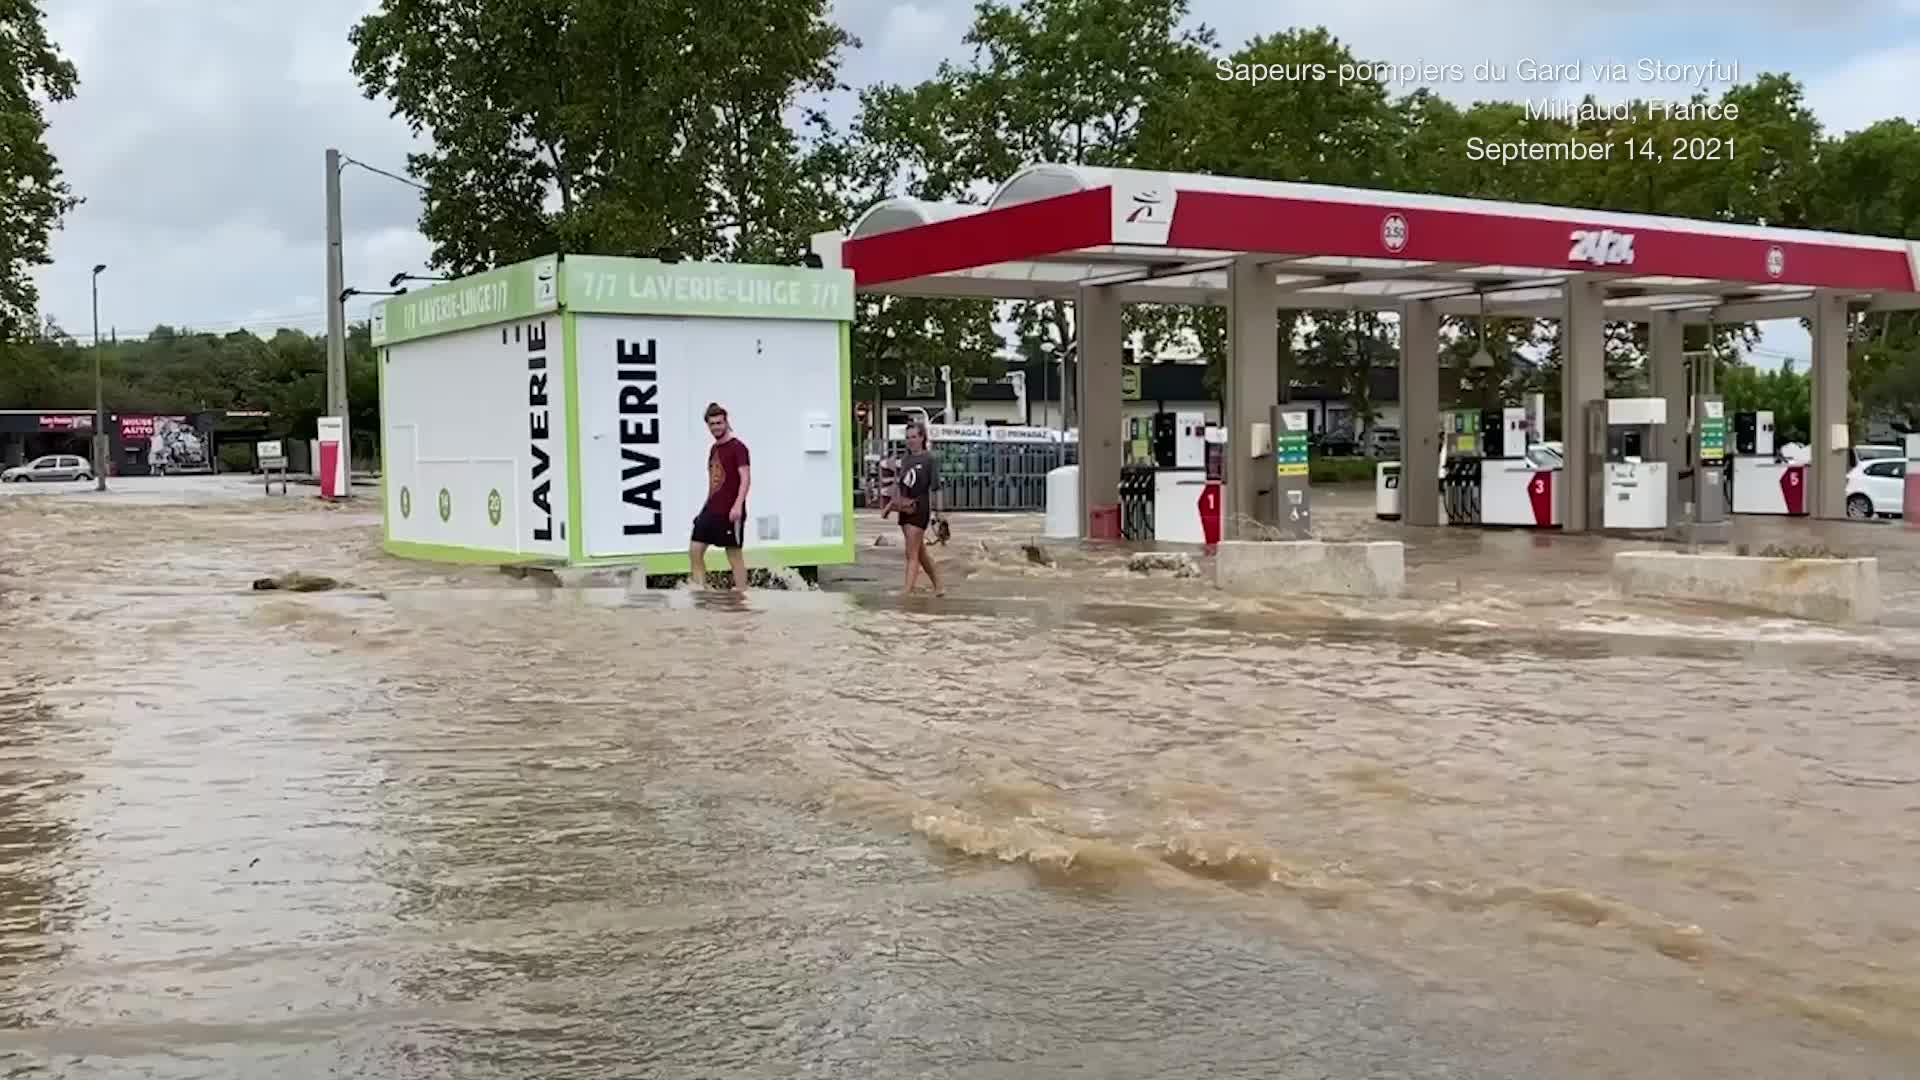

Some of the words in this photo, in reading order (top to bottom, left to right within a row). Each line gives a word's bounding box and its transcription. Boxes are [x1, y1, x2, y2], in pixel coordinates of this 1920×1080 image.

[418, 282, 493, 325] LAVERIE-LINGE
[584, 272, 617, 301] 7/7
[628, 274, 801, 305] LAVERIE-LINGE
[811, 282, 840, 310] 7/7
[122, 426, 153, 435] AUTO
[527, 320, 552, 541] LAVERIE
[616, 338, 663, 536] LAVERIE
[1534, 479, 1545, 494] 3
[1790, 471, 1800, 486] 5
[1206, 493, 1215, 510] 1
